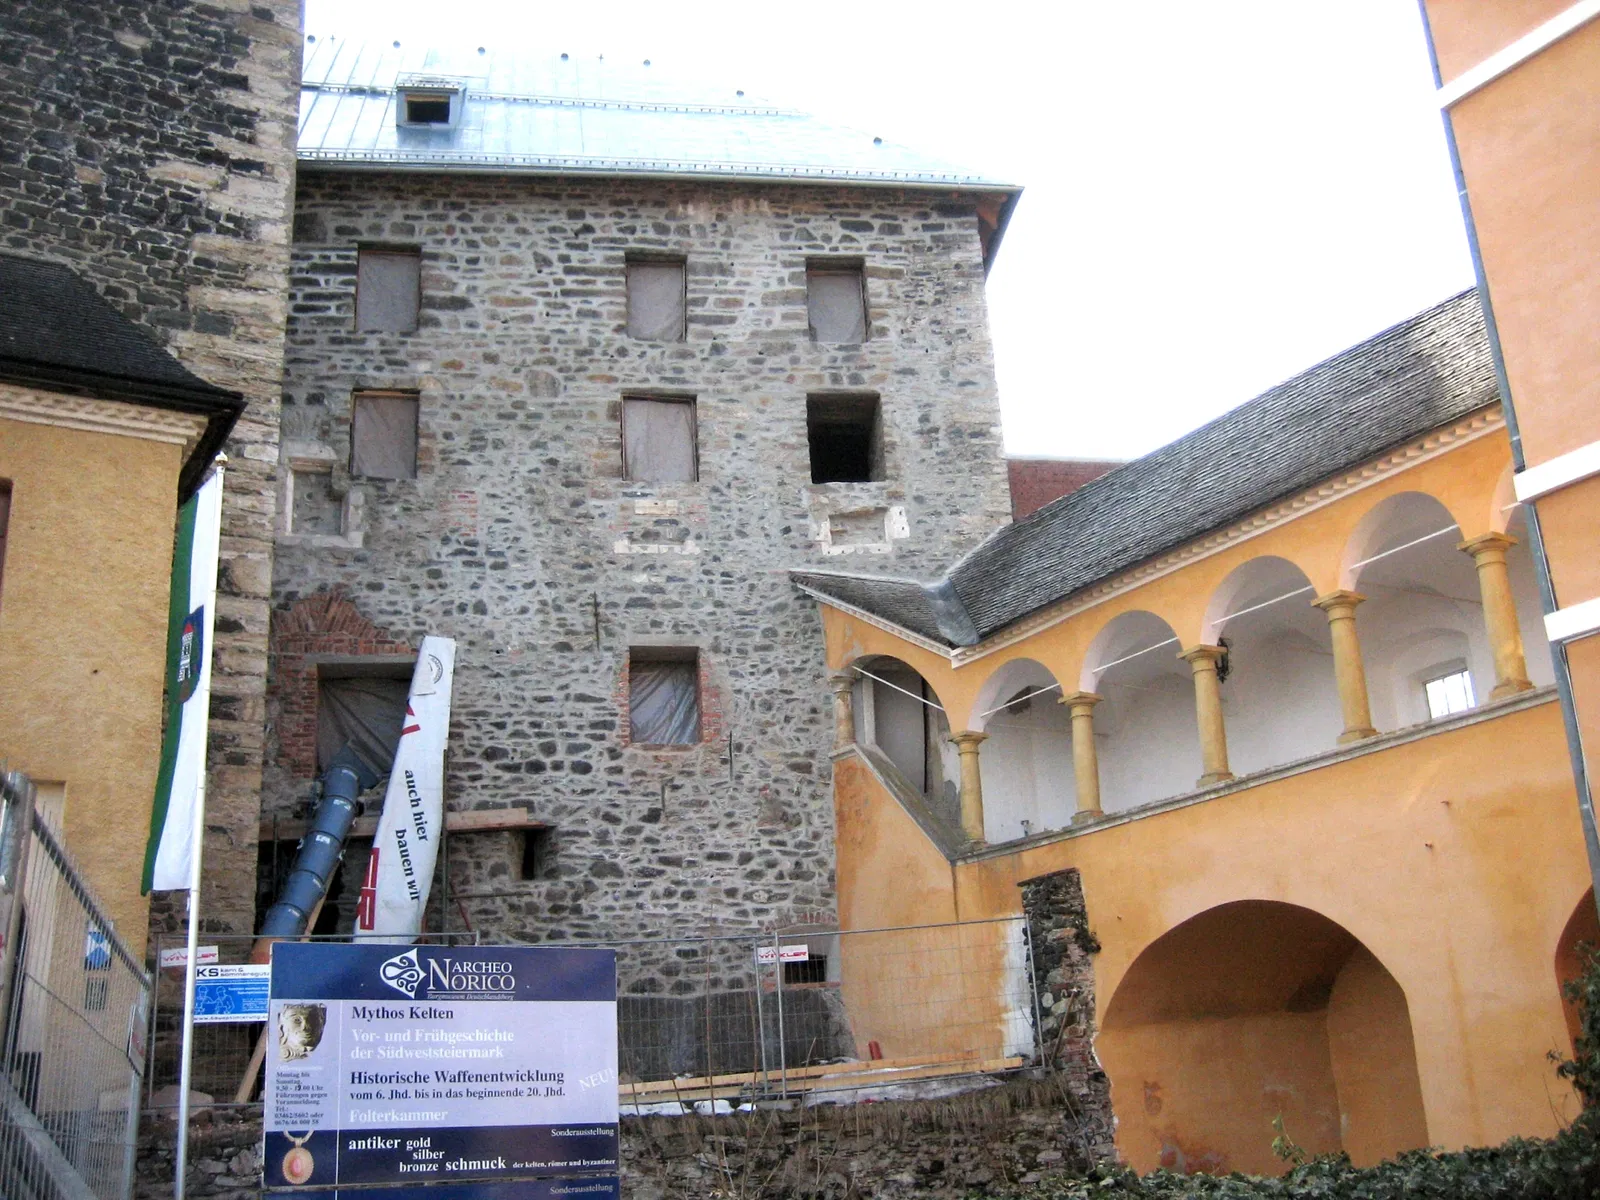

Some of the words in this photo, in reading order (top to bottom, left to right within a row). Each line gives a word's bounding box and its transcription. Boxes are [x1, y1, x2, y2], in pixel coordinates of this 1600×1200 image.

[405, 769, 421, 809] auch
[412, 811, 429, 842] hier
[395, 828, 414, 877] bauen
[197, 968, 219, 977] KS
[427, 958, 516, 991] NORICO
[352, 1006, 404, 1022] Mythos
[409, 1006, 454, 1019] Kelten
[352, 1029, 380, 1042] Vor-
[385, 1029, 410, 1042] und
[415, 1028, 514, 1045] Frühgeschichte
[351, 1046, 374, 1060] der
[377, 1045, 504, 1060] Südweststeiermark
[350, 1071, 430, 1085] Historische
[434, 1070, 564, 1085] Waffenentwicklung
[579, 1068, 616, 1091] NEU!
[350, 1091, 373, 1100] vom
[376, 1089, 385, 1099] 6.
[388, 1089, 411, 1100] Jhd.
[414, 1088, 430, 1099] bis
[432, 1088, 443, 1098] in
[445, 1088, 463, 1098] das
[466, 1087, 524, 1100] beginnende
[527, 1087, 541, 1097] 20.
[544, 1086, 565, 1097] Jhd.
[350, 1109, 448, 1123] Folterkammer
[551, 1127, 615, 1138] Sonderausstellung
[348, 1136, 401, 1150] antiker
[406, 1137, 431, 1151] gold
[412, 1149, 445, 1160] silber
[399, 1161, 439, 1173] bronze
[445, 1157, 507, 1171] schmuck
[582, 1158, 616, 1167] byzantiner
[550, 1184, 613, 1195] Sonderausstellung
